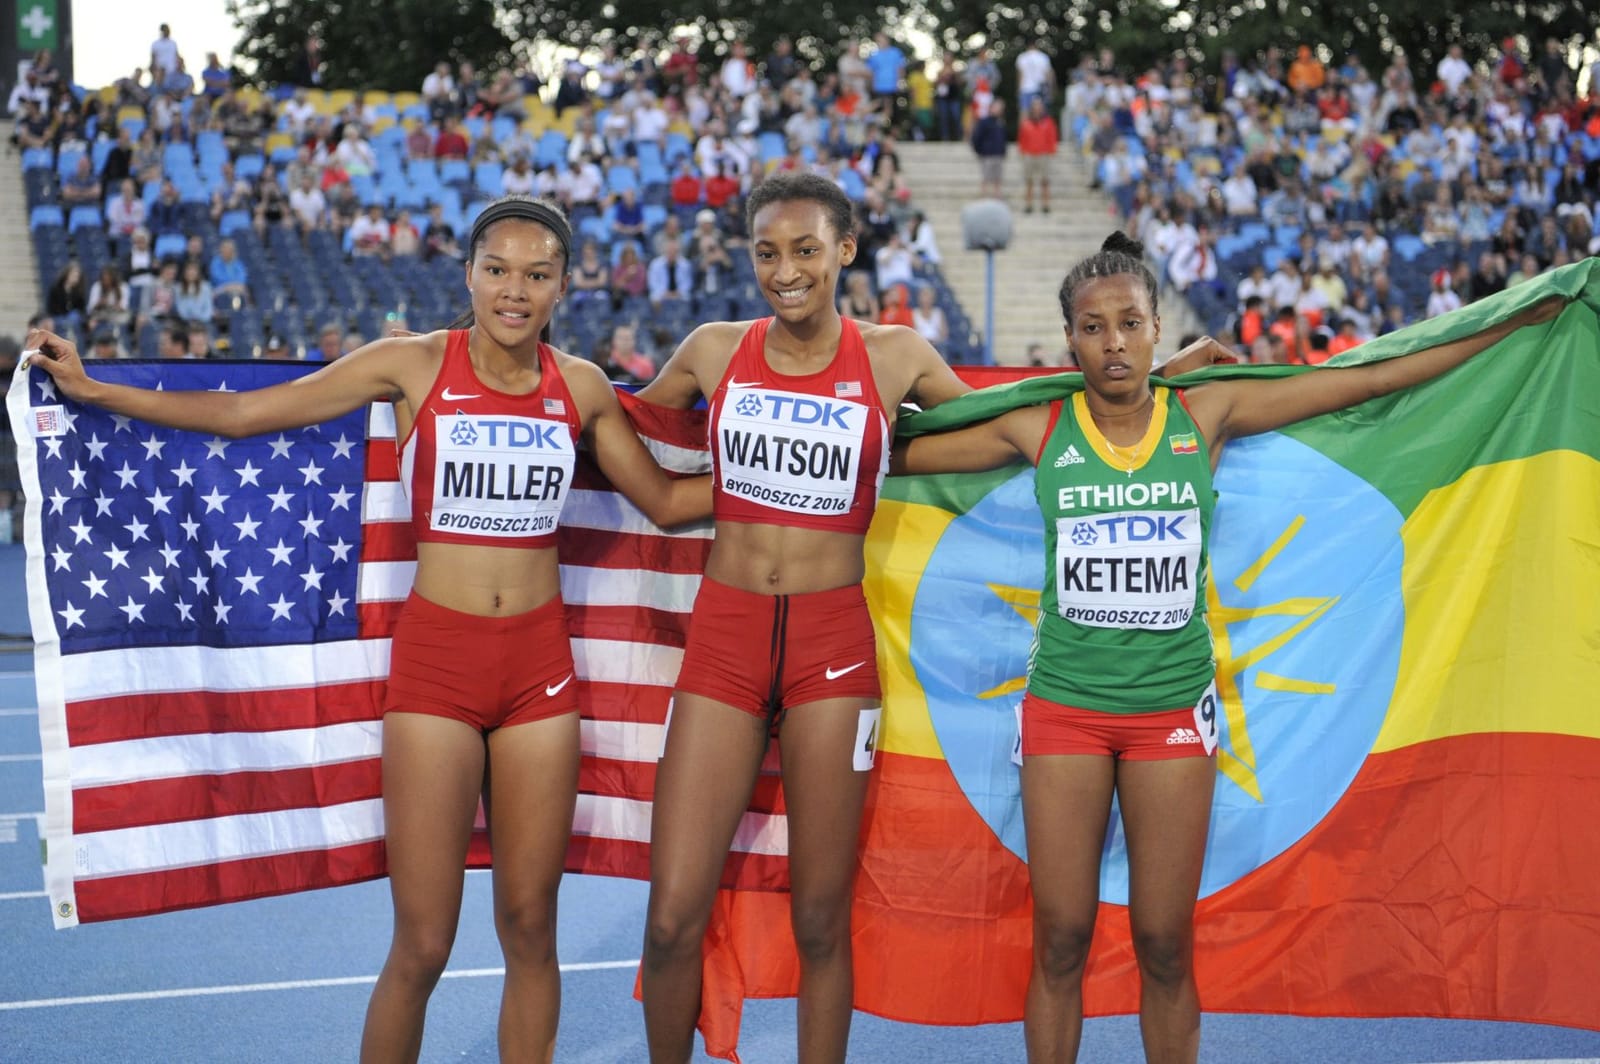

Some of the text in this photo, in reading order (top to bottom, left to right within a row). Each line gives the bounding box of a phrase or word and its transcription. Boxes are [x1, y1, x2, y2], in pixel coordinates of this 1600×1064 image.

[764, 395, 853, 430] TDK
[477, 421, 562, 450] TDK
[723, 429, 852, 482] WATSON
[1054, 454, 1086, 468] adidas
[442, 461, 564, 501] MILLER
[725, 478, 848, 511] BYDGOSZCZ 2016
[1058, 481, 1198, 510] ETHIOPIA
[438, 512, 554, 532] BYDGOSZCZ 2016
[1096, 515, 1187, 544] TDK
[1063, 556, 1189, 594] KETEMA
[1065, 607, 1189, 625] BYDGOSZCZ 2016
[1200, 694, 1216, 738] 9
[864, 719, 877, 761] 4
[1166, 734, 1201, 745] adidas
